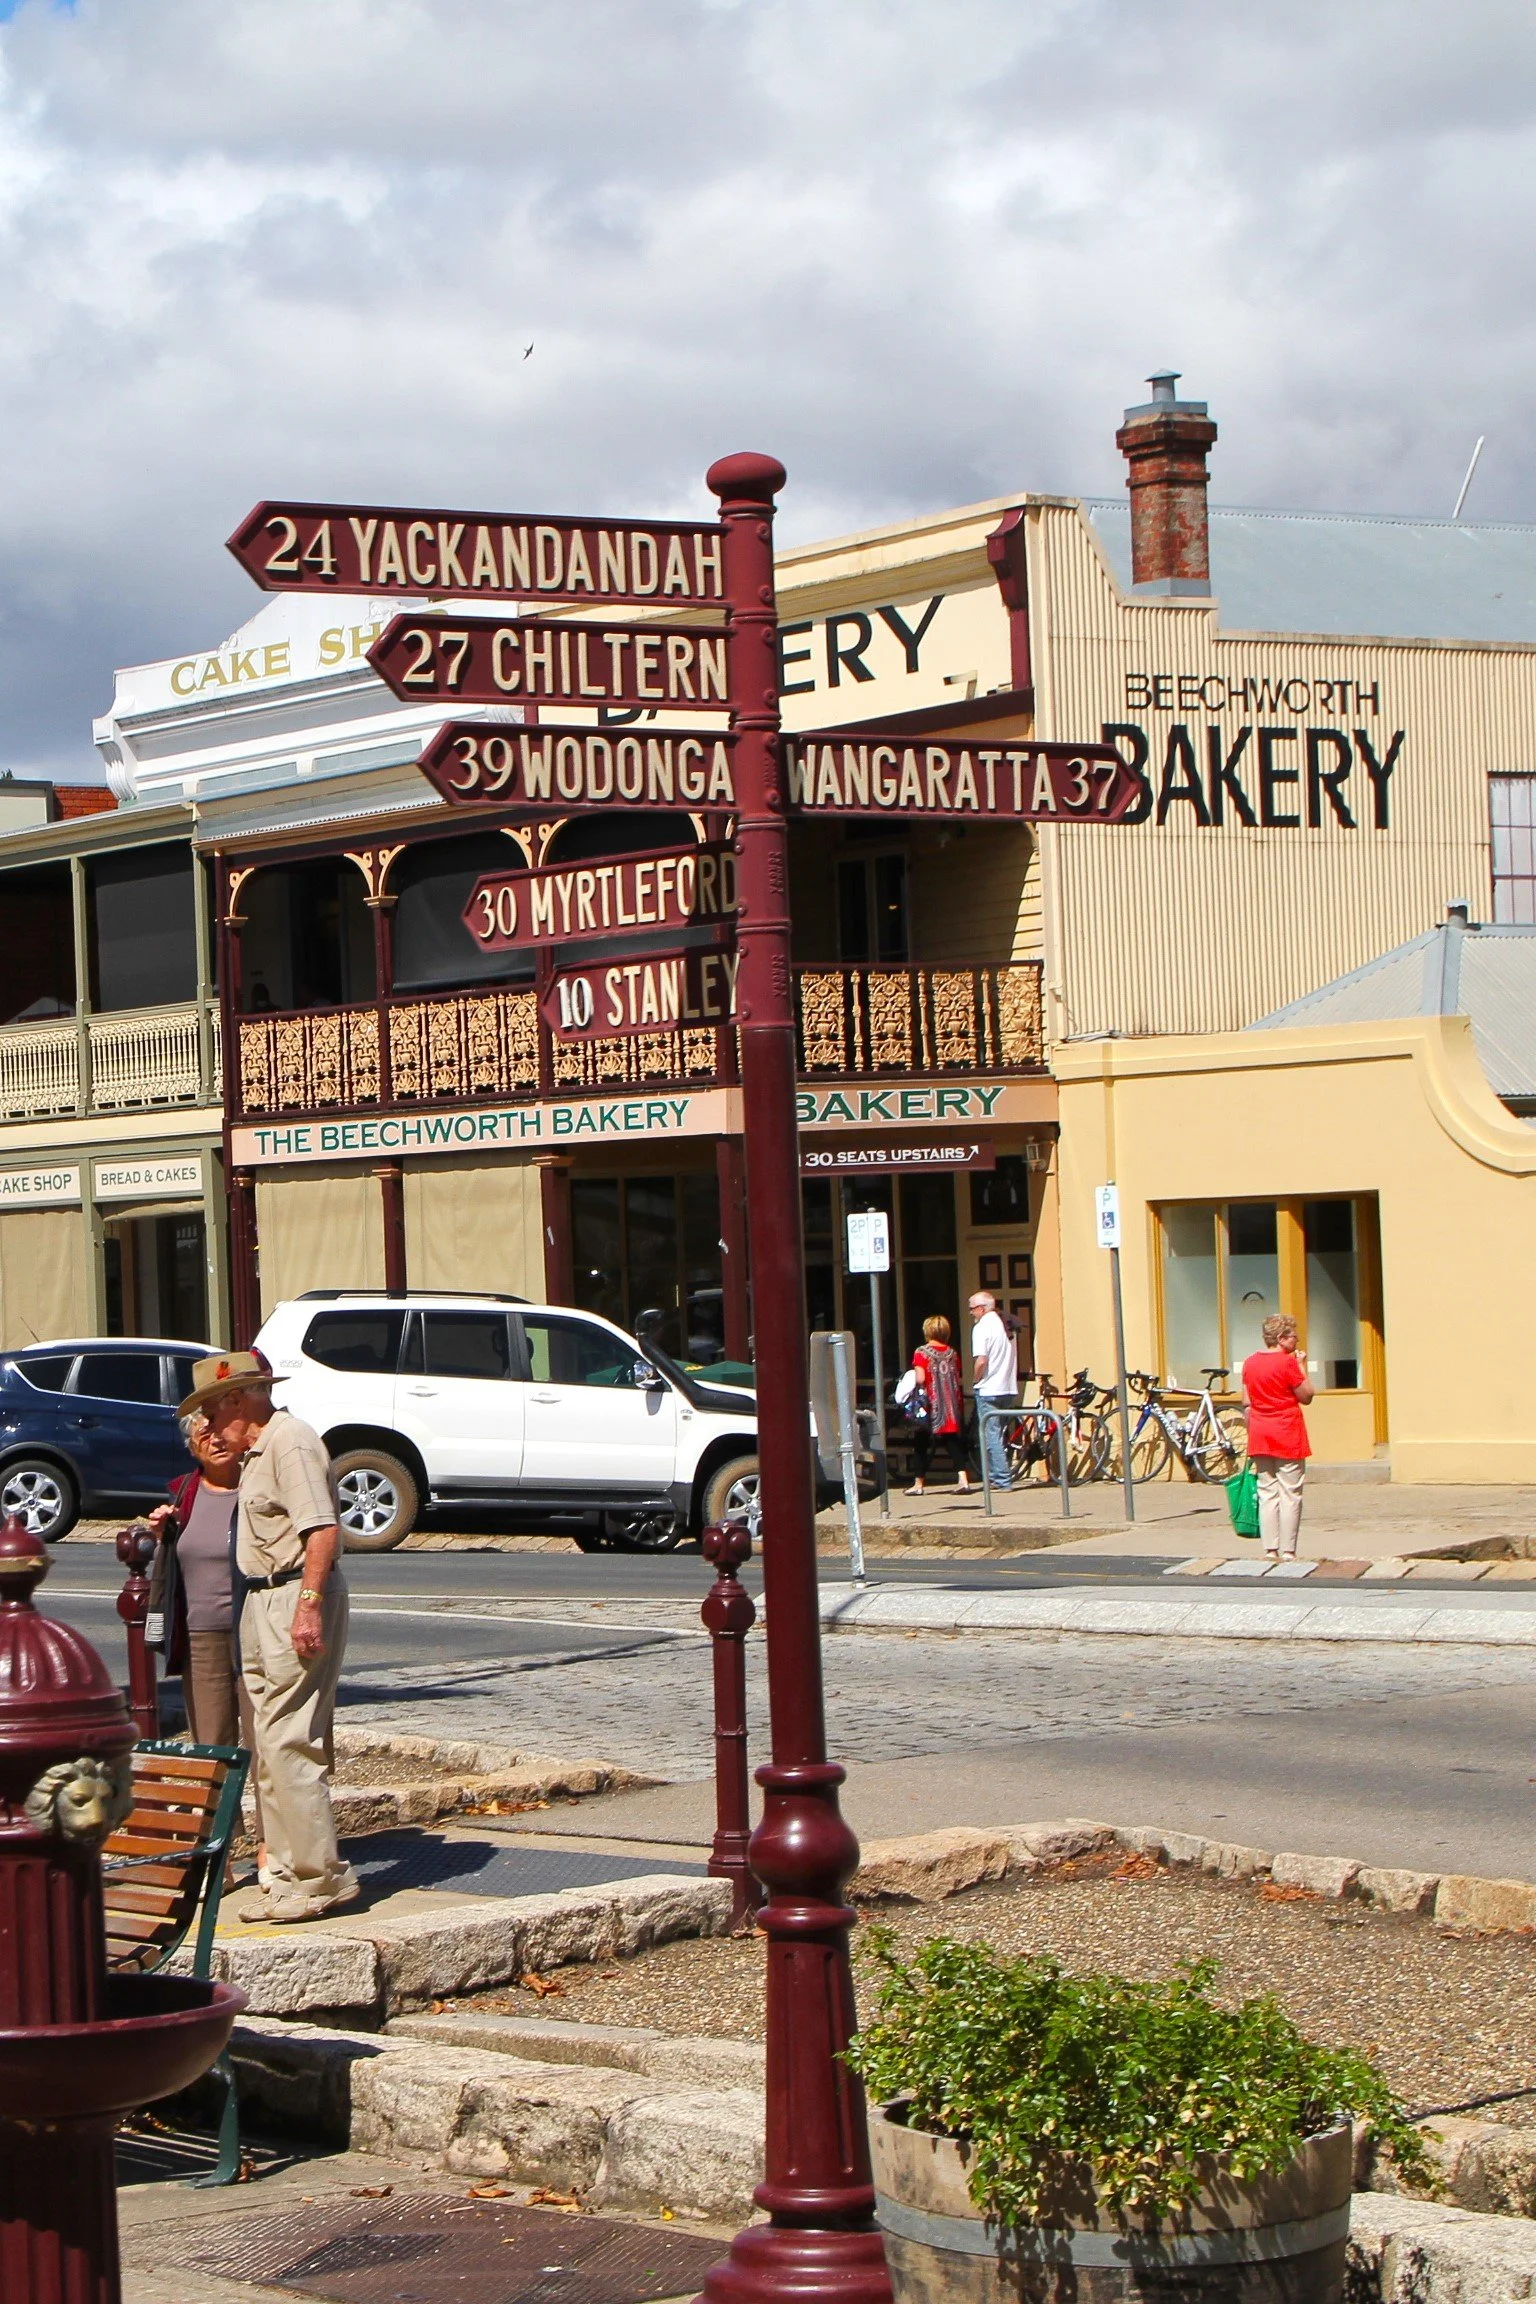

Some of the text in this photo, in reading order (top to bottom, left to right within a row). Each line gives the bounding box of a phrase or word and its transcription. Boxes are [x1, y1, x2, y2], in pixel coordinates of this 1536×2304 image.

[264, 516, 724, 598] 24 YACKANDANDAH
[170, 620, 384, 696] CAKE SH
[402, 627, 728, 701] 27 CHILTERN
[1125, 673, 1380, 716] BEECHWORTH
[448, 736, 515, 793] 39
[520, 733, 736, 803] WODONGA
[786, 743, 1058, 812] WANGARATTA
[1062, 757, 1118, 810] 37
[1101, 722, 1406, 830] BAKERY
[476, 886, 518, 939] 30
[530, 850, 740, 937] MYRTLEFORD
[556, 976, 593, 1029] 10
[604, 952, 740, 1027] STANLEY
[254, 1099, 691, 1156] THE BEECHWORTH BAKERY
[796, 1087, 1004, 1124] BAKERY
[0, 1173, 72, 1194] AKE SHOP
[101, 1166, 198, 1186] BREAD & CAKES
[837, 1150, 887, 1163] SEATS
[891, 1147, 965, 1161] UPSTAIRS
